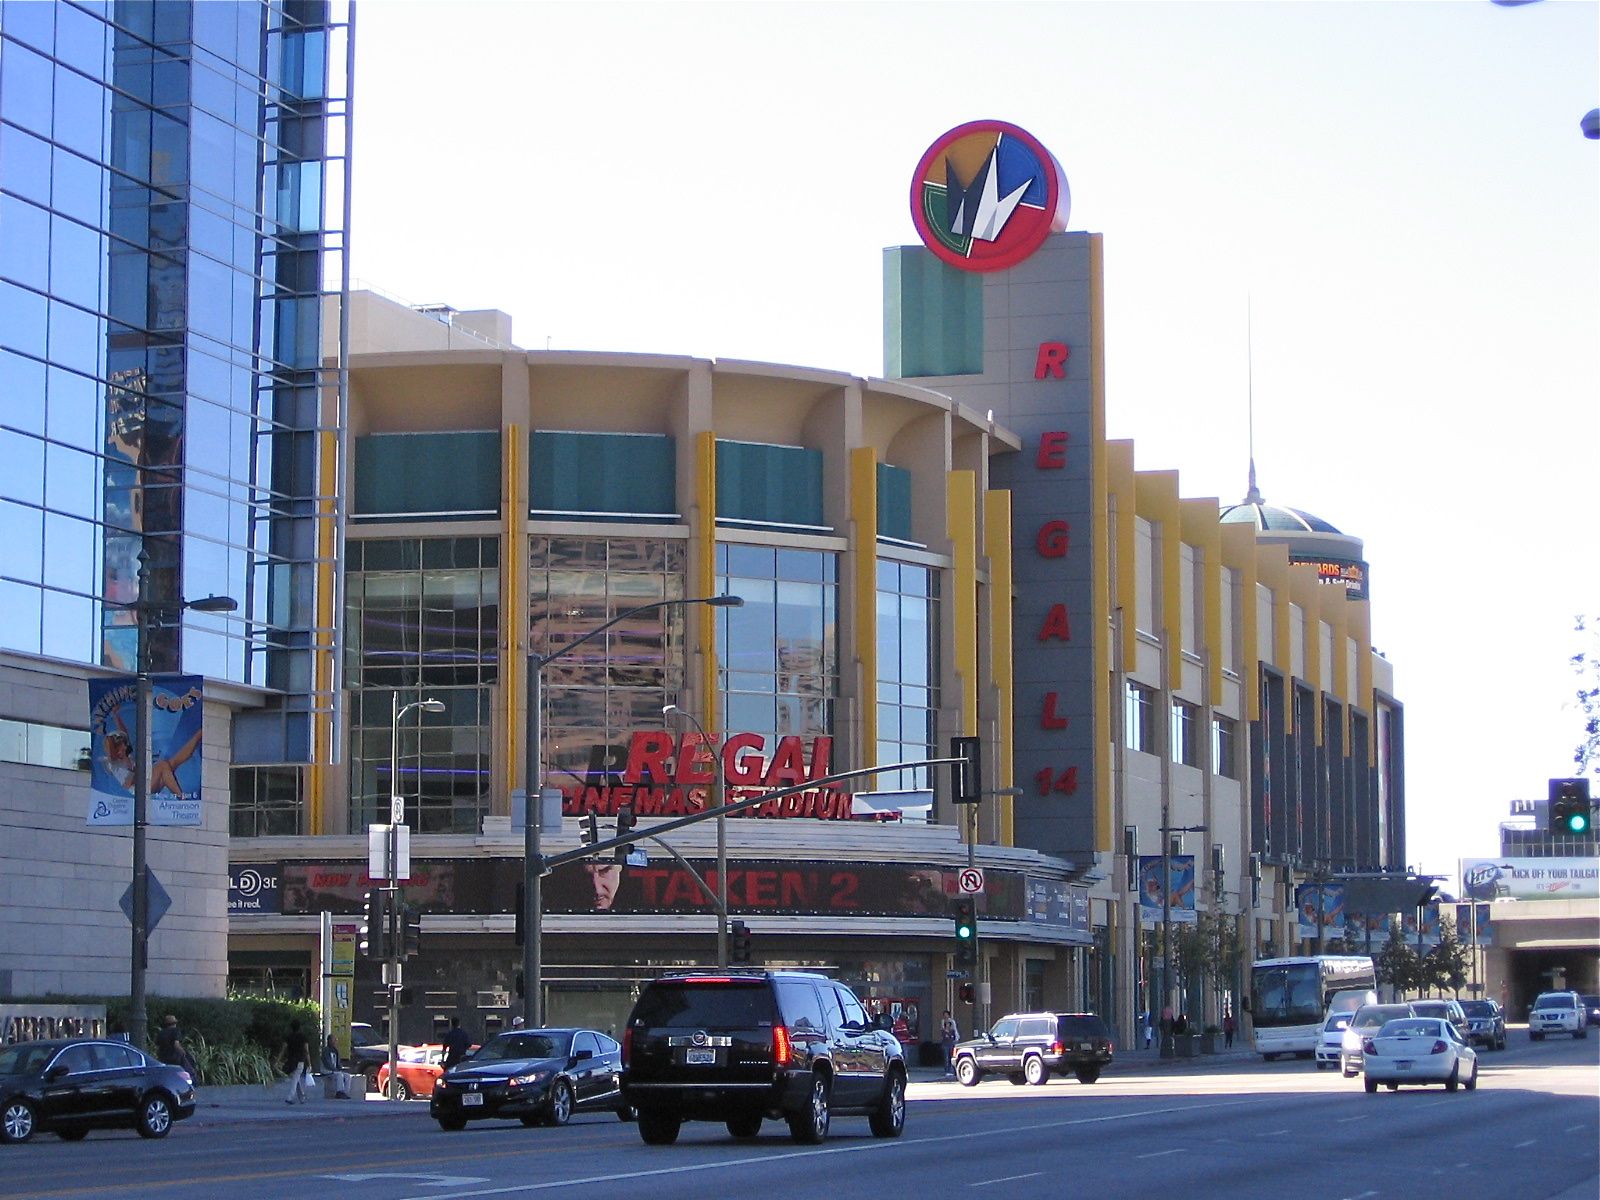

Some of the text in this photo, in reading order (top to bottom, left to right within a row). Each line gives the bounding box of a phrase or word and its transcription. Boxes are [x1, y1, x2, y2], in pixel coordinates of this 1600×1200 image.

[1034, 342, 1078, 797] REGAL 14
[624, 731, 846, 789] REGAL
[159, 801, 200, 811] Ahmanson
[628, 870, 860, 908] TAKEN 2
[1512, 868, 1530, 879] KICK
[1548, 868, 1568, 879] YOUR
